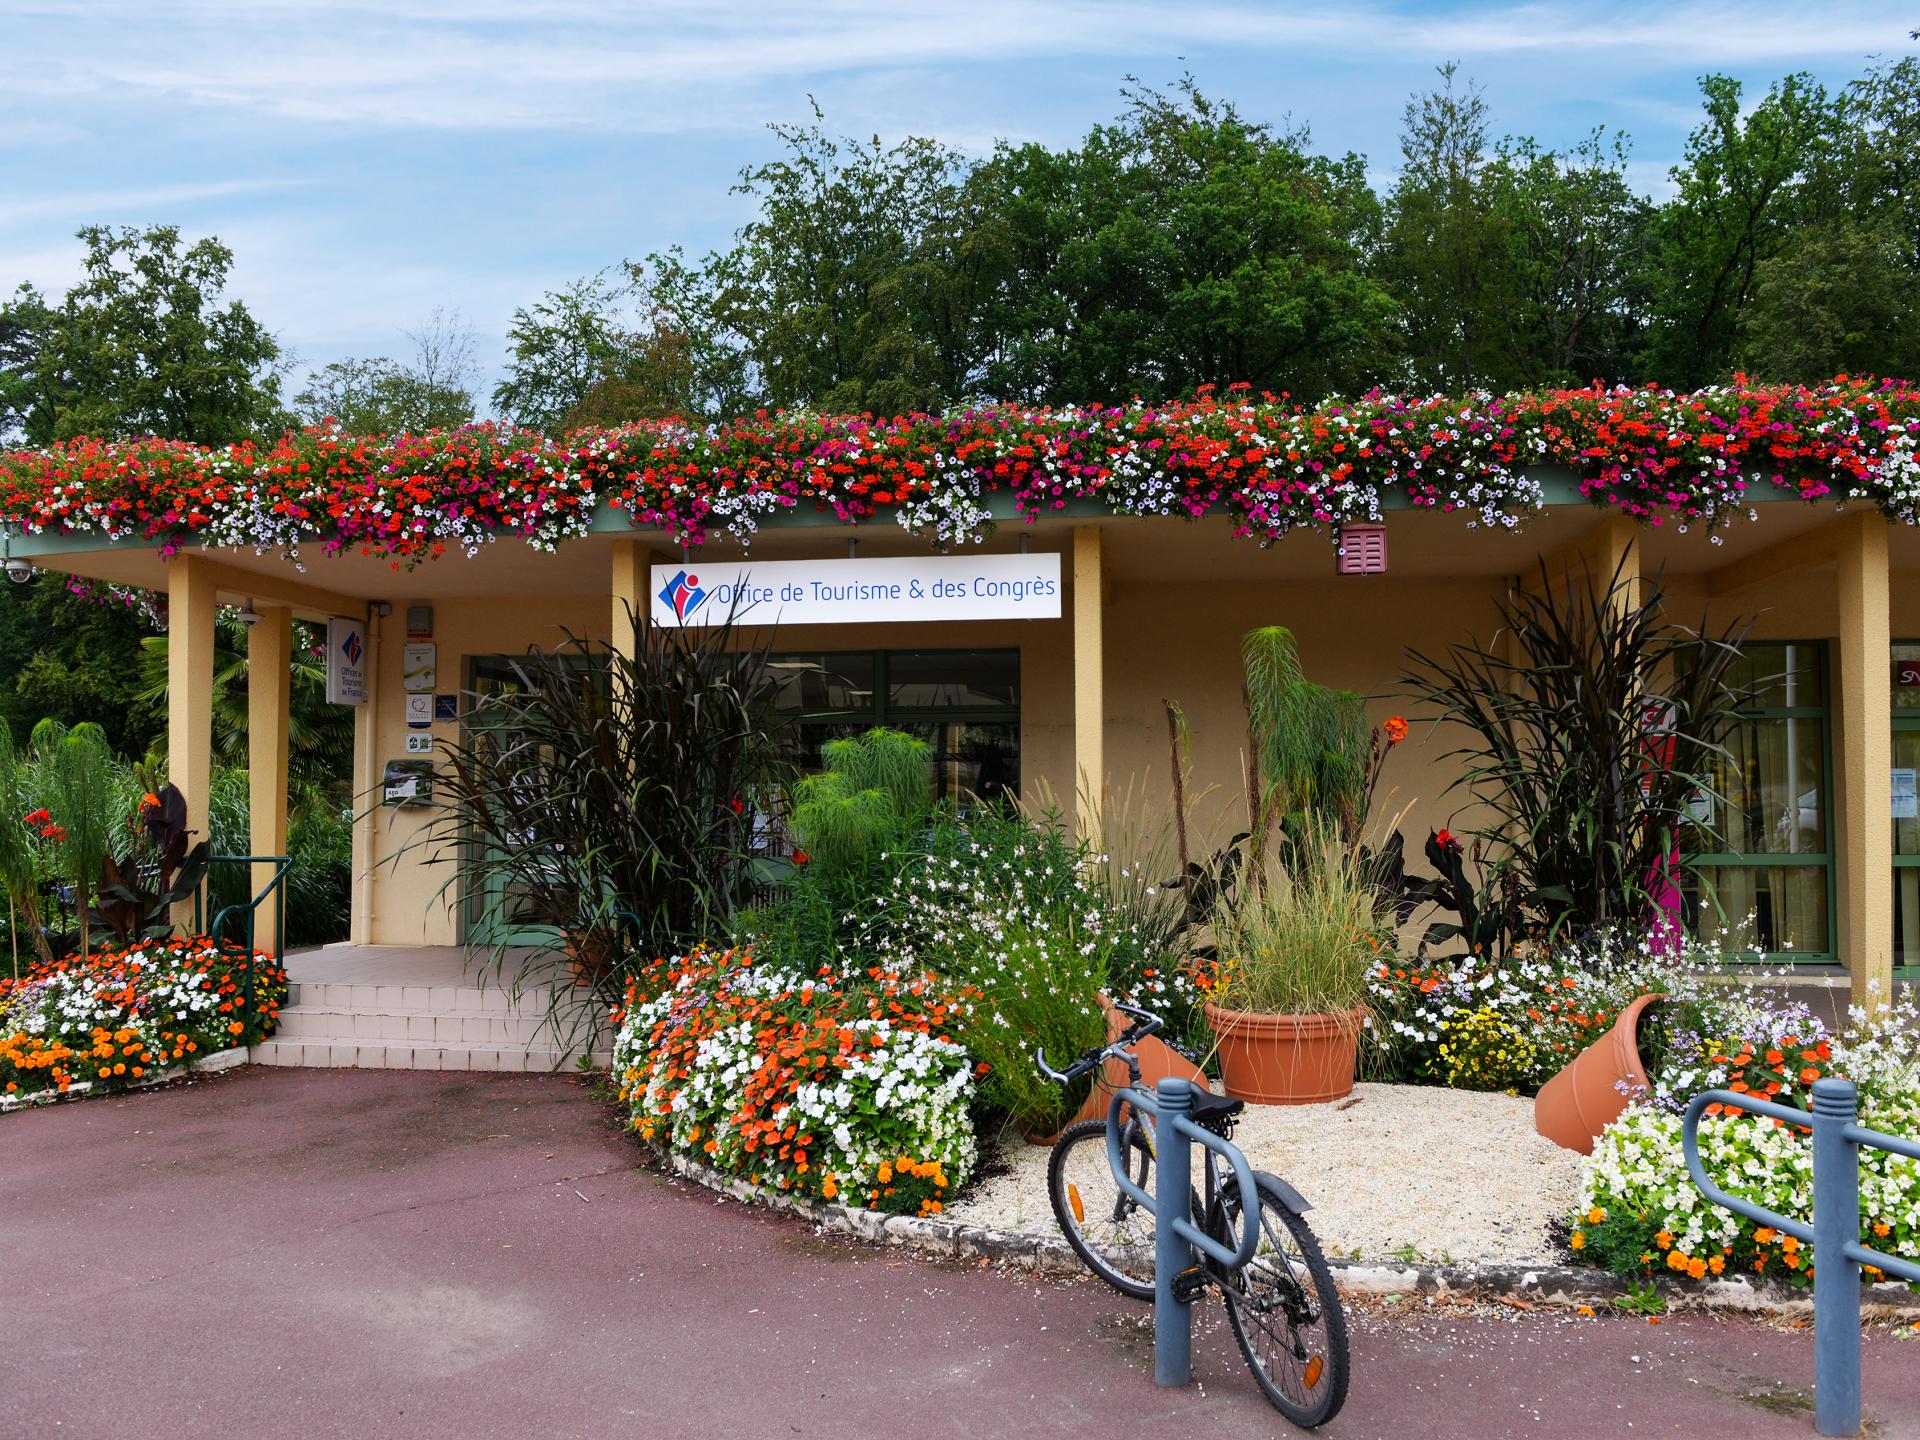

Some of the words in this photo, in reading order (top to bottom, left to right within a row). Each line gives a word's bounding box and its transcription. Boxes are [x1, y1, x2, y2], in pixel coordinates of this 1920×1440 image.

[718, 583, 773, 604] Office
[780, 582, 803, 602] de
[810, 580, 901, 600] Tourisme
[909, 579, 924, 598] &
[932, 578, 966, 598] des
[974, 575, 1055, 601] Congrès
